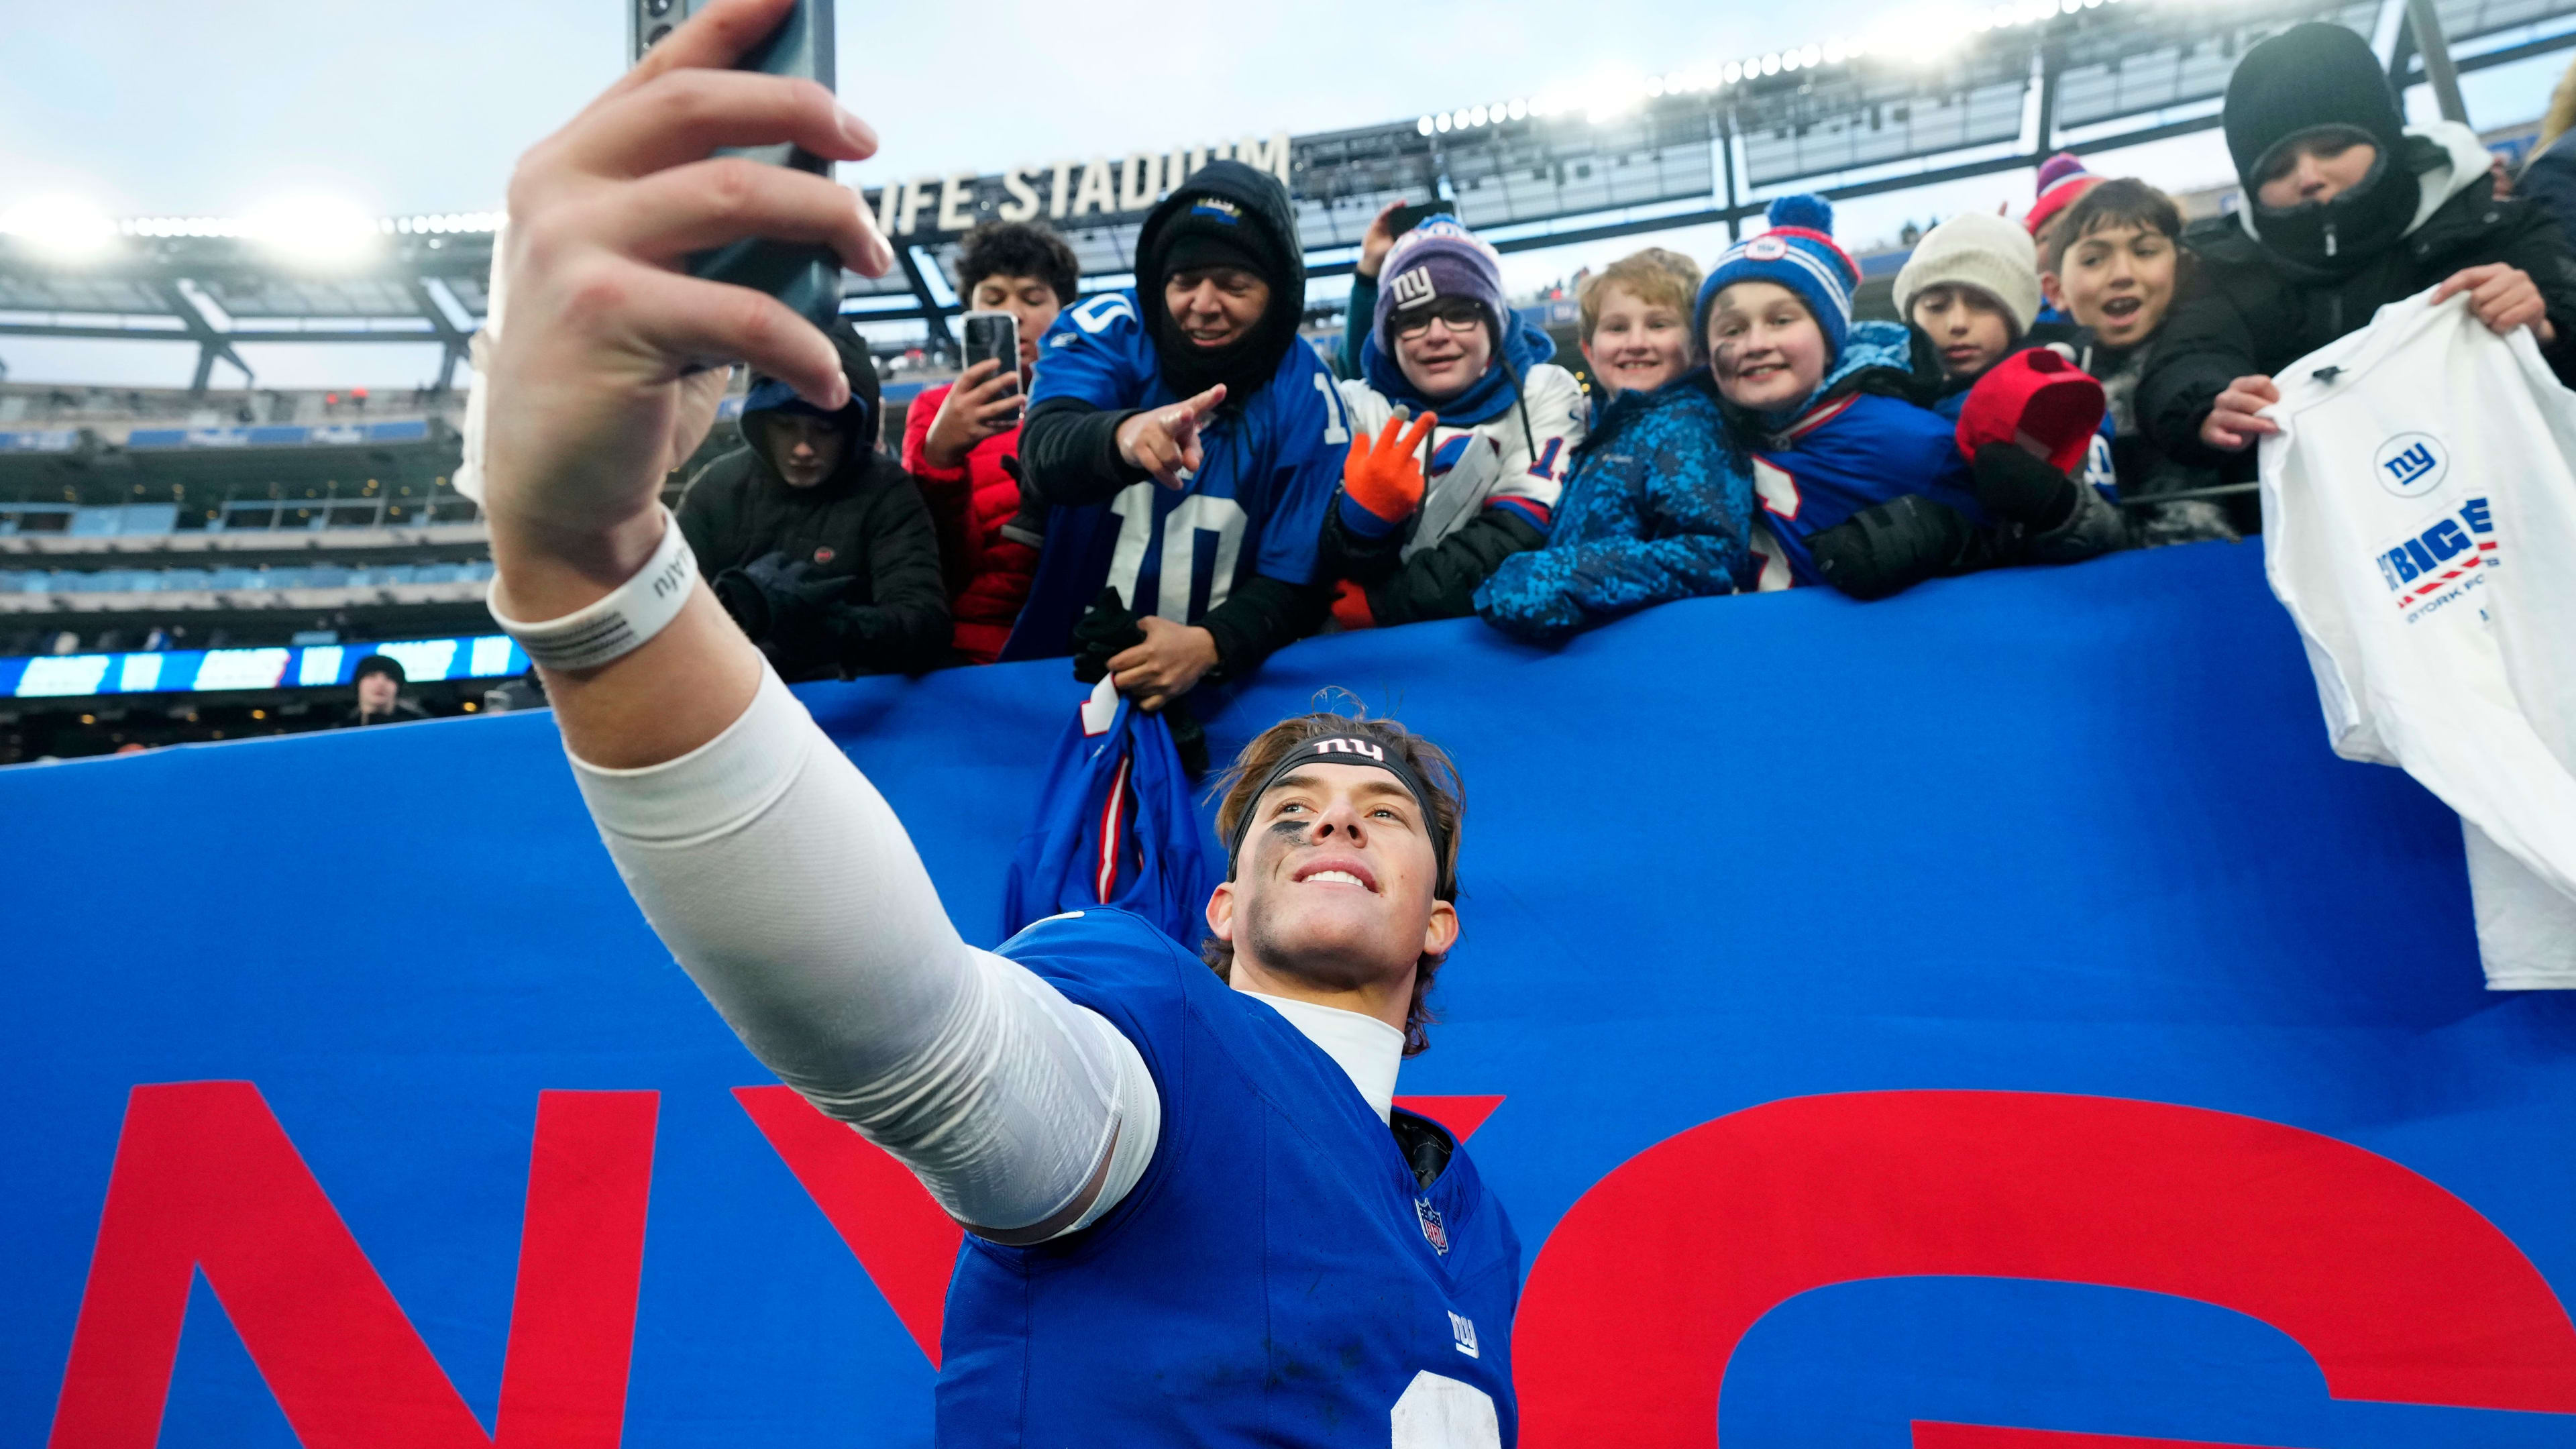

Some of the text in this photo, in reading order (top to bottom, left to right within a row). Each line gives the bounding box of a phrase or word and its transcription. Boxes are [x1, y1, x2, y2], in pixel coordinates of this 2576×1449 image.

[859, 170, 978, 237] IFE
[1085, 482, 1248, 626] 10
[1424, 1219, 1446, 1246] NFL
